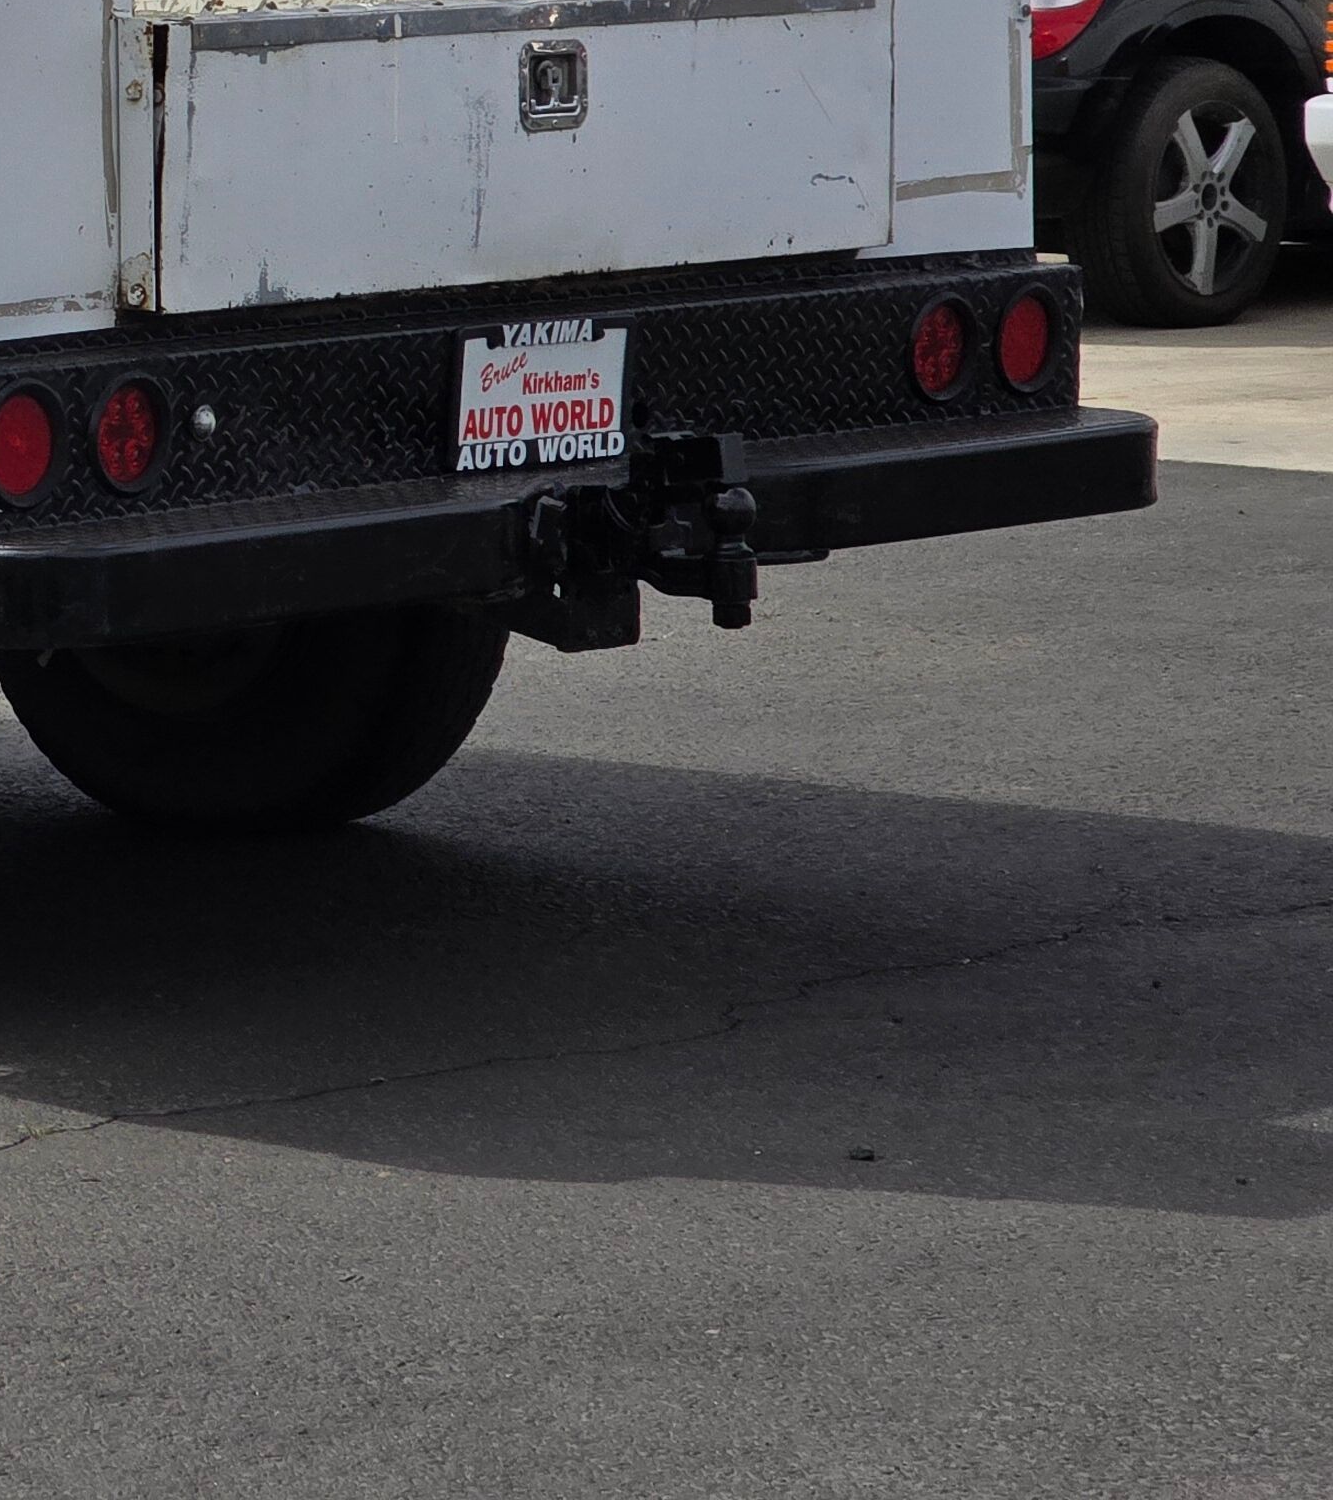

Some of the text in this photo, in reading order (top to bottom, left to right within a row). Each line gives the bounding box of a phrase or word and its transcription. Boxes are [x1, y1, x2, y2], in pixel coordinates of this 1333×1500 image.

[502, 318, 593, 348] YAKIMA
[480, 351, 600, 396] Bruce Kirkham's
[462, 397, 615, 442] AUTO WORLD
[455, 431, 626, 471] AUTO WORLD
